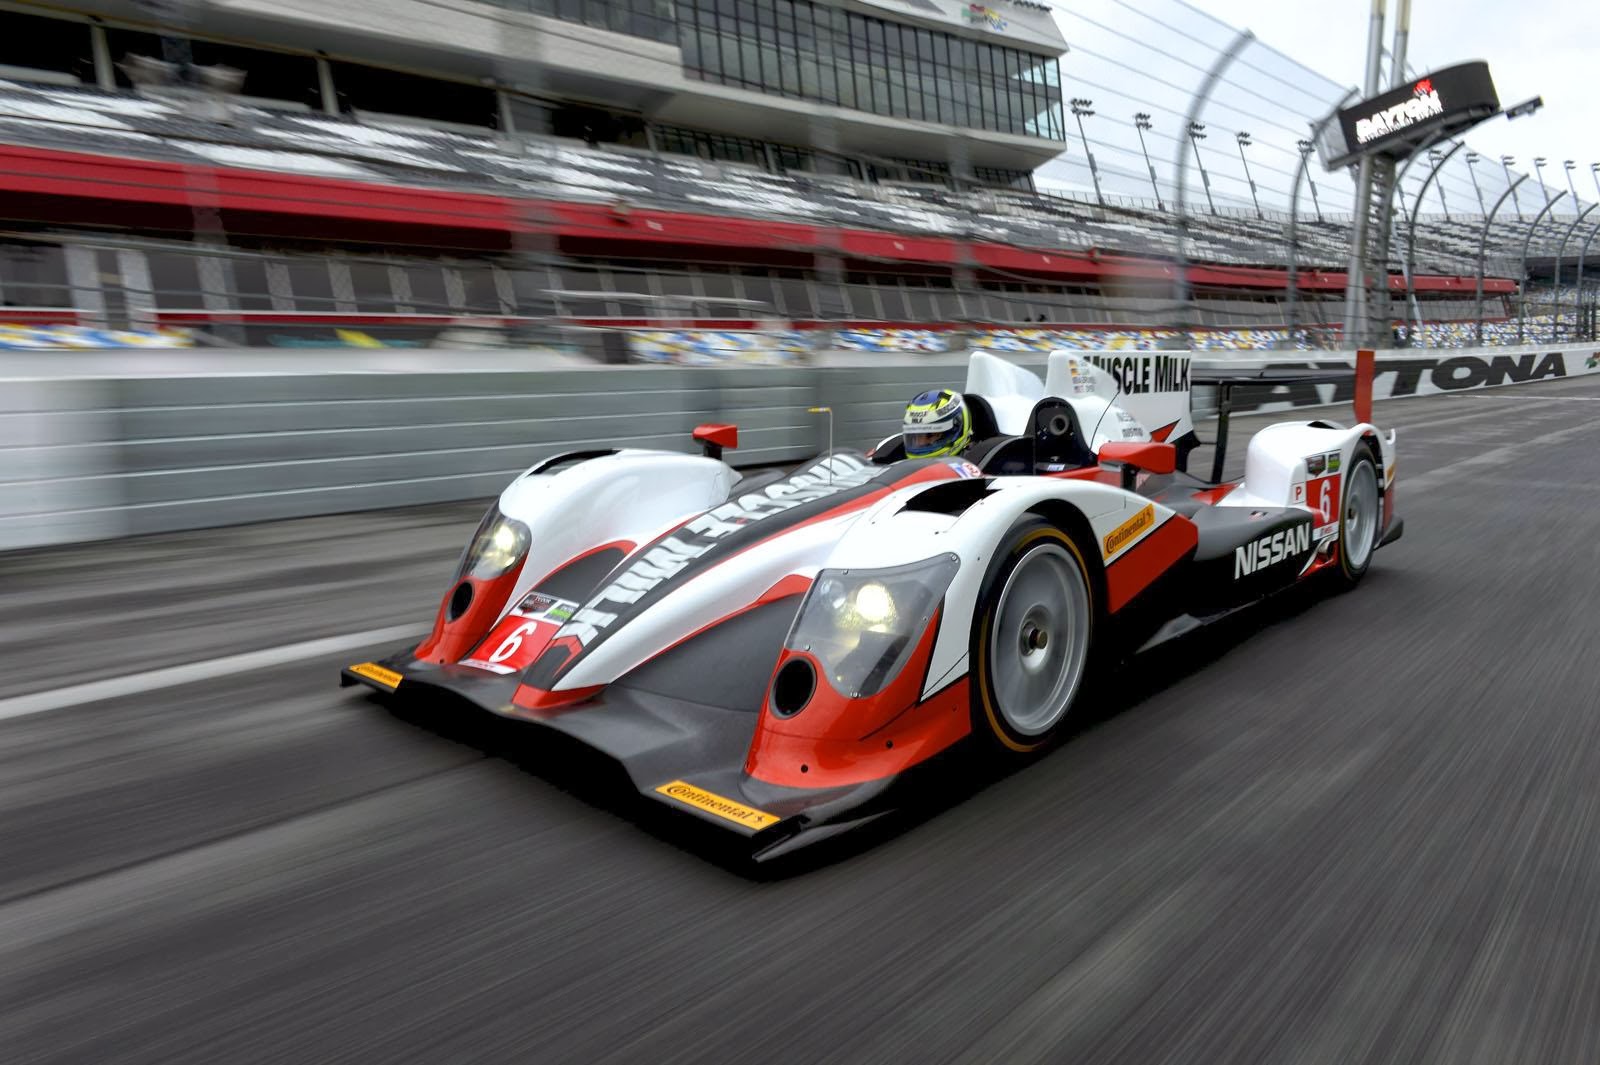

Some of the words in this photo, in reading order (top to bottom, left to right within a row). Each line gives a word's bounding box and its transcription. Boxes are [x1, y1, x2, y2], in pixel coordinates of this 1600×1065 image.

[1155, 356, 1190, 393] MILK
[1320, 479, 1331, 524] 6
[1106, 511, 1146, 554] Continental
[1234, 522, 1310, 580] NISSAN
[551, 536, 718, 648] MILK
[488, 621, 538, 664] 6
[666, 785, 754, 820] Continental
